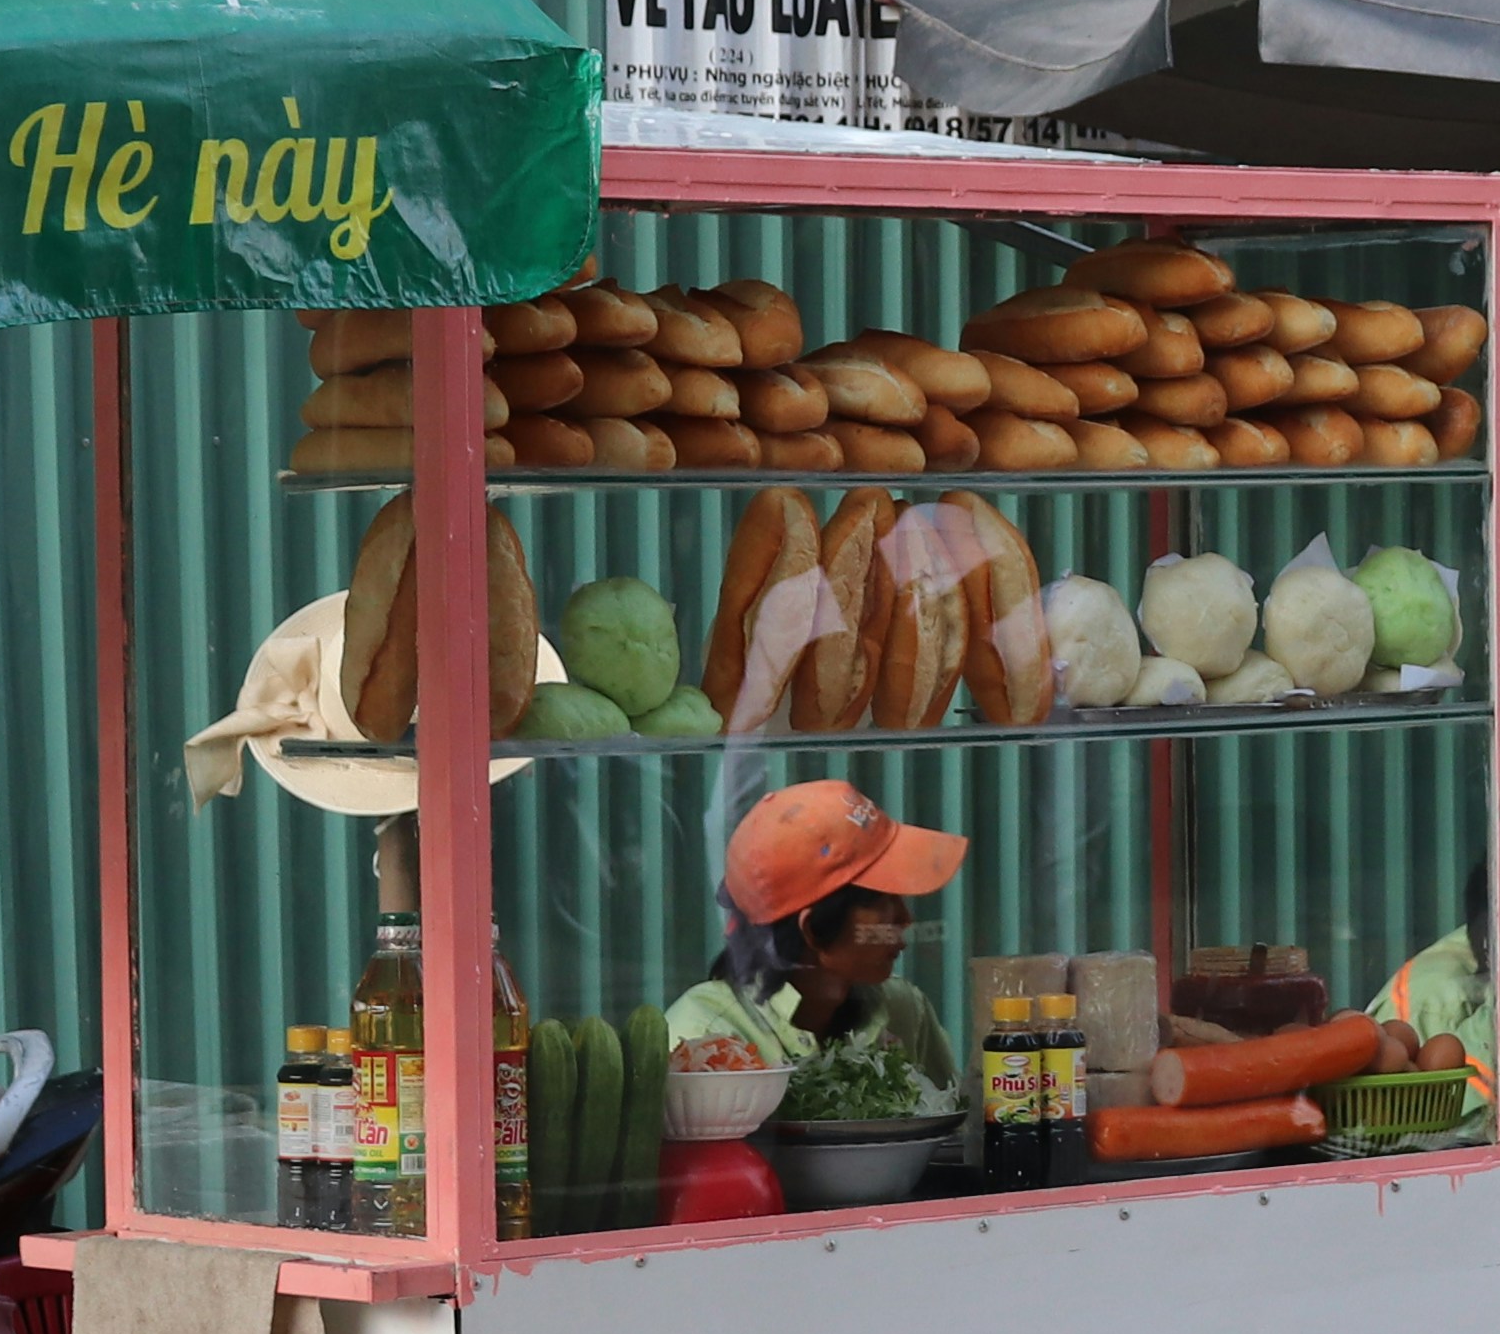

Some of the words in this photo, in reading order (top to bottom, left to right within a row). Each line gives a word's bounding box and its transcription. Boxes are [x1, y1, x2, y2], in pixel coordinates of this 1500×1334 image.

[817, 71, 850, 91] biệt
[823, 95, 846, 109] VN)
[8, 99, 160, 238] Hè
[188, 96, 394, 262] này
